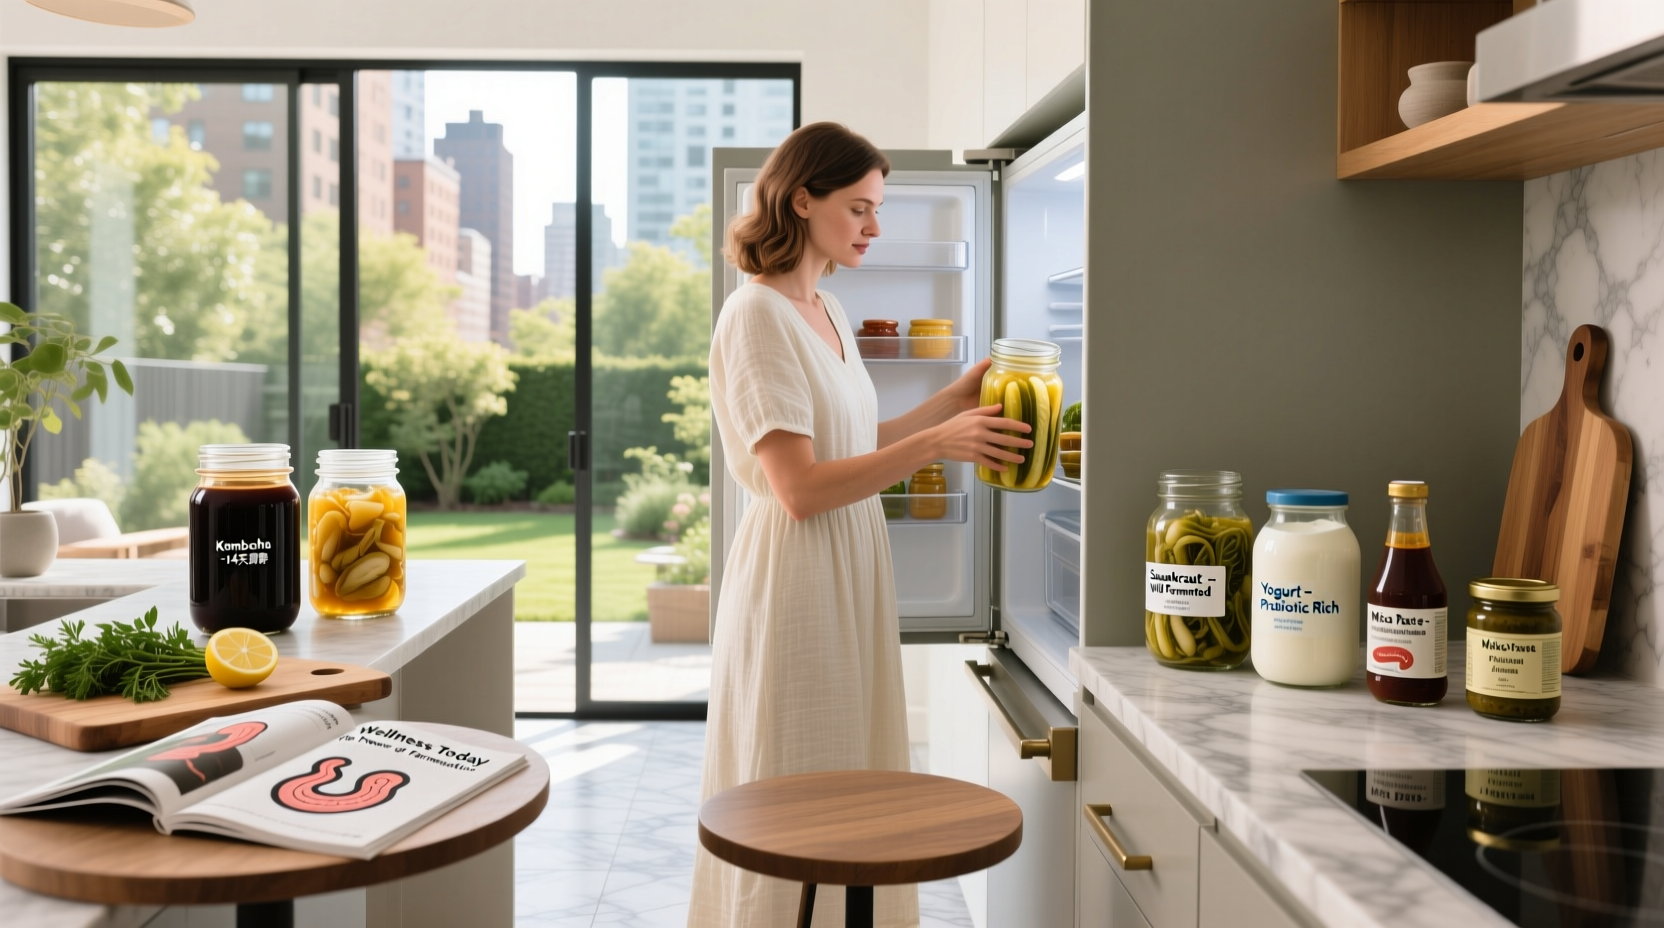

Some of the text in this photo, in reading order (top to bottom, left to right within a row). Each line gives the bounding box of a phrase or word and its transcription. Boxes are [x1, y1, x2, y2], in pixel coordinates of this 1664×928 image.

[1260, 581, 1301, 600] Yogurt
[1312, 600, 1340, 614] Rich
[359, 725, 433, 751] Wellness
[438, 744, 490, 767] Today
